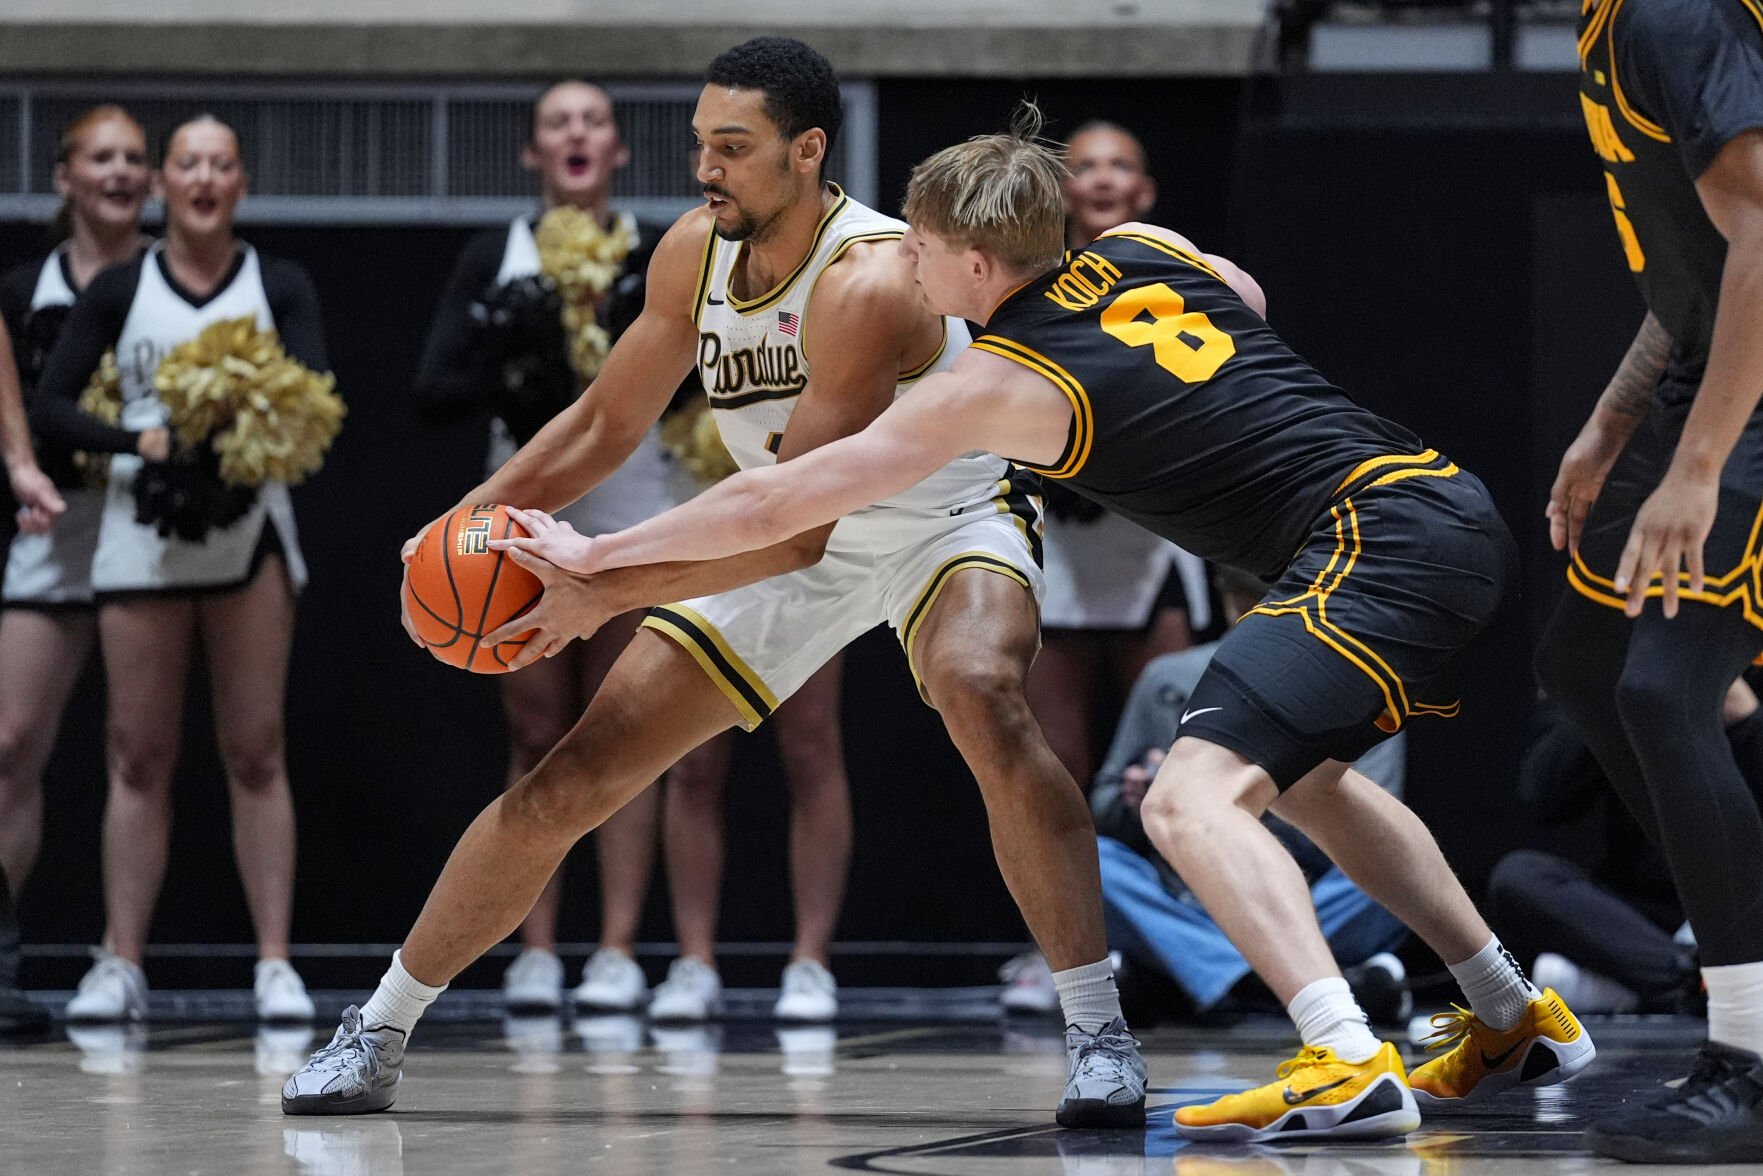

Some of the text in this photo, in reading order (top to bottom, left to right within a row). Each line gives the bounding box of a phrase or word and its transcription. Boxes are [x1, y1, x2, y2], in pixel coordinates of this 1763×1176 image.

[1044, 251, 1123, 312] KOCH
[699, 331, 807, 395] Purdue
[1100, 282, 1237, 384] 8
